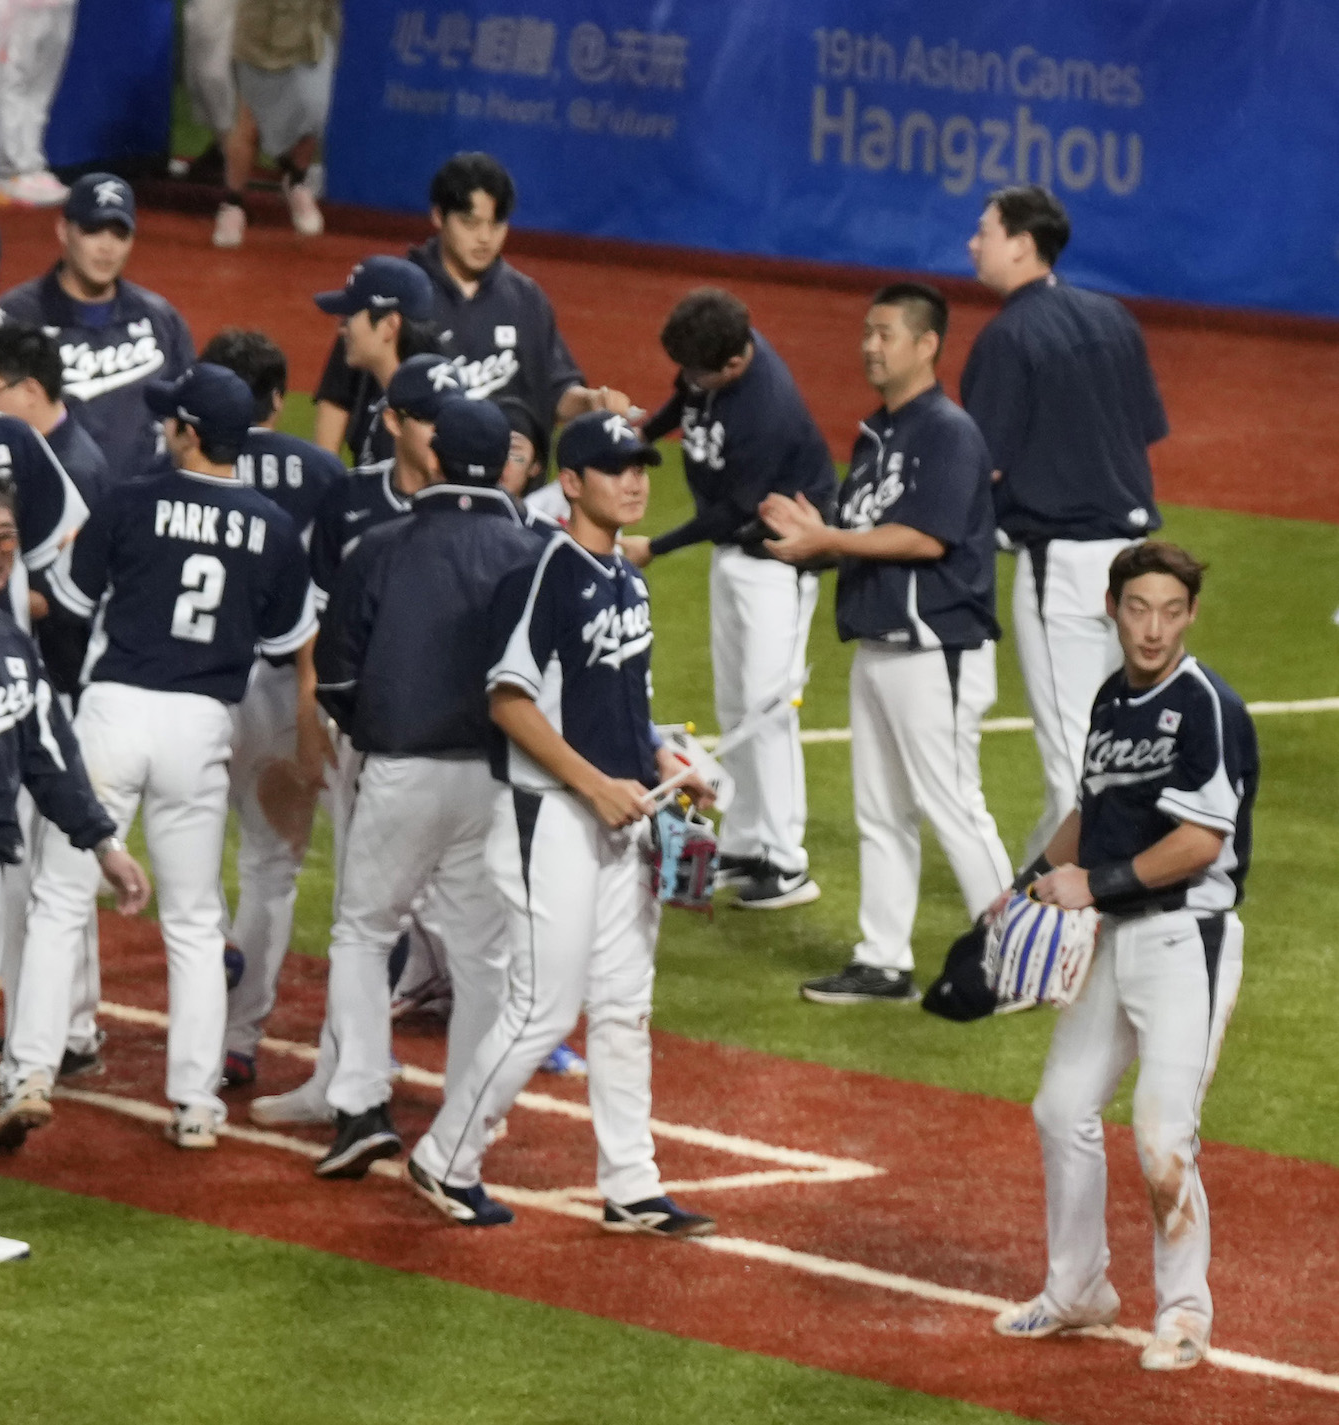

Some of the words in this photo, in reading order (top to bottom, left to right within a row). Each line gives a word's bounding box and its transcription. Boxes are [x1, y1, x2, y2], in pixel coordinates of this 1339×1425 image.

[812, 29, 896, 83] 19th
[900, 36, 1003, 94] Asian
[1012, 46, 1143, 107] Games
[811, 85, 1143, 194] Hangzhou
[154, 499, 221, 546] PARK
[224, 509, 244, 549] S
[170, 552, 227, 645] 2
[1084, 729, 1180, 796] Korea
